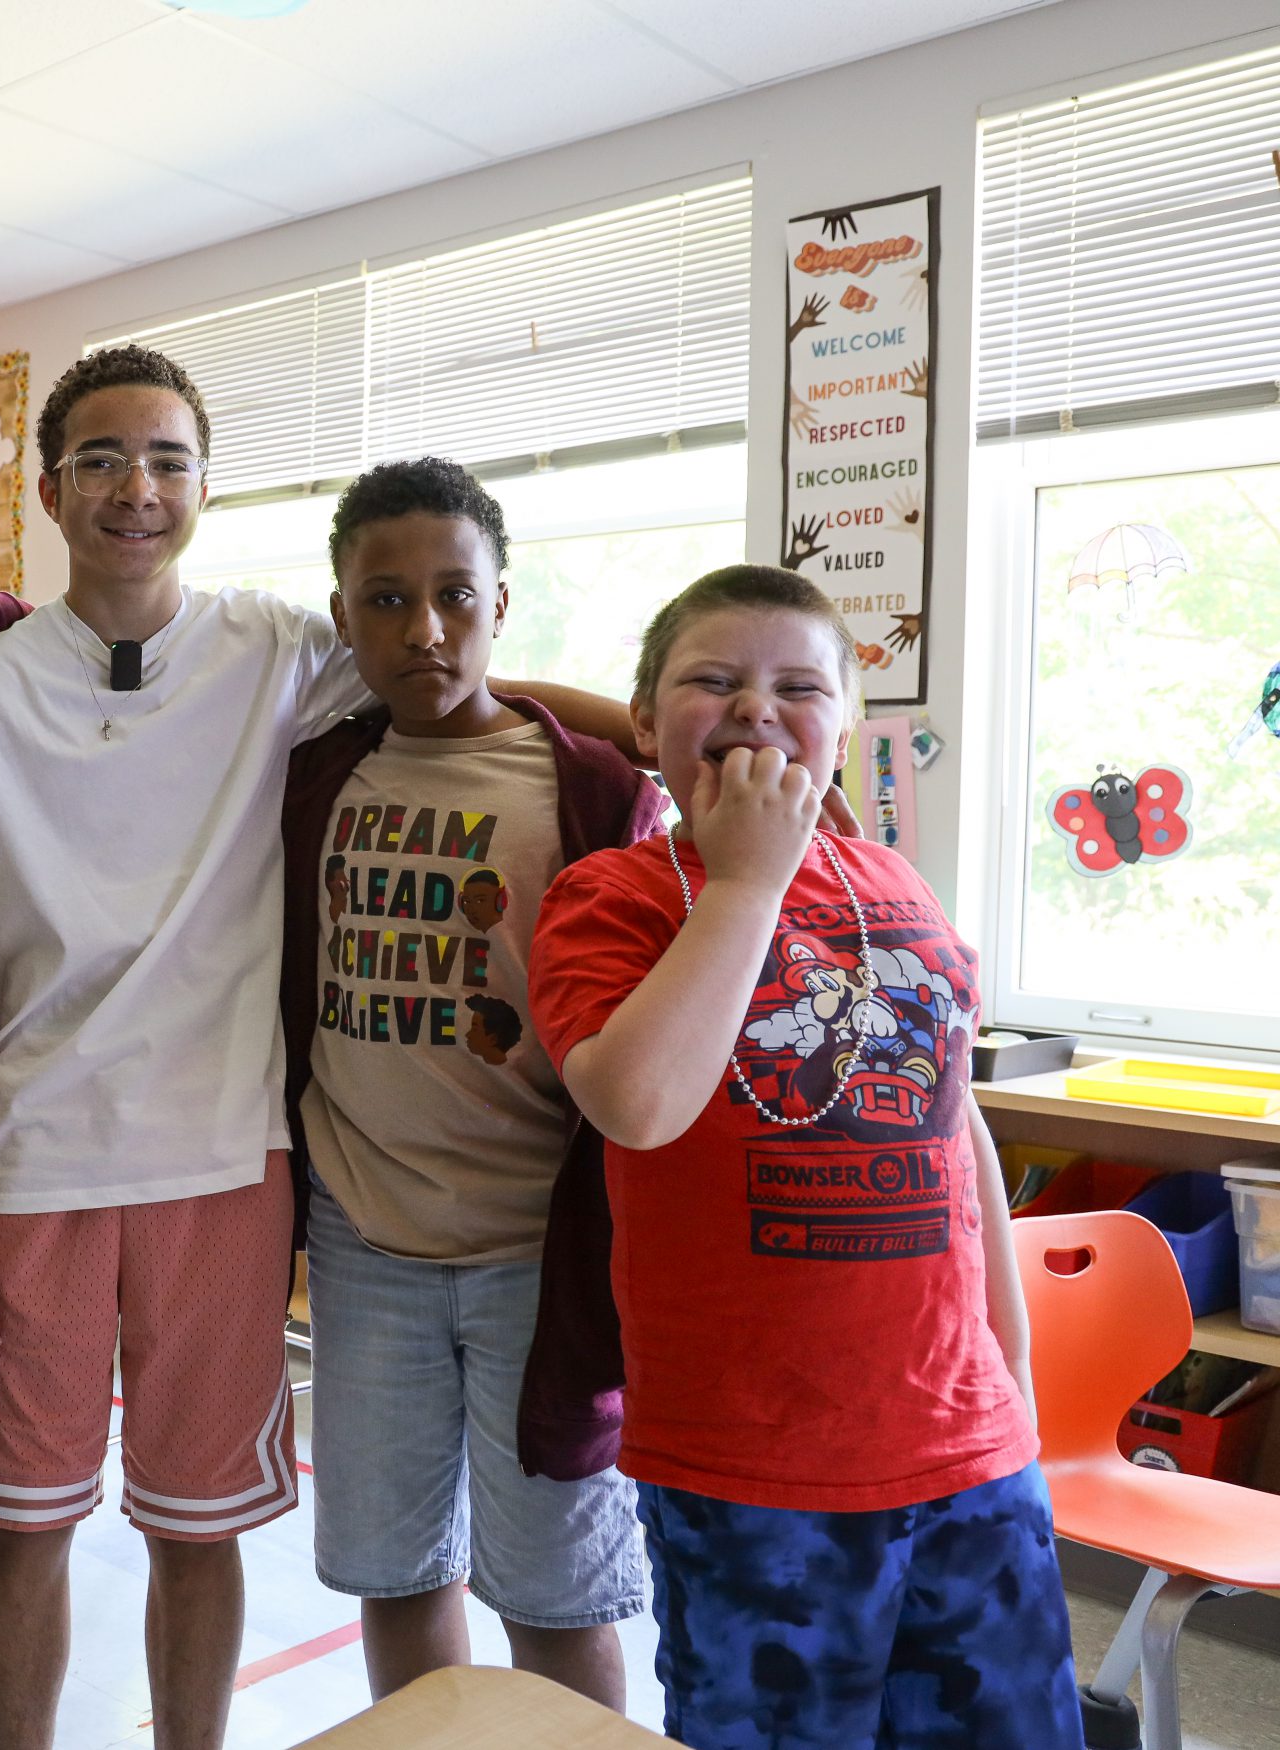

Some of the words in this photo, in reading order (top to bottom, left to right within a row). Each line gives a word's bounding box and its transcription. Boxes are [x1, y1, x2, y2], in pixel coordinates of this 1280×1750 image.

[794, 235, 920, 276] Everyone
[811, 326, 906, 358] WELCOME
[808, 370, 908, 402] IMPORTANT
[809, 415, 906, 445] RESPECTED
[796, 458, 918, 489] ENCOURAGED
[826, 506, 884, 529] LOVED
[824, 551, 885, 572] VALUED
[834, 593, 906, 614] BRATED
[333, 805, 498, 862] DREAM
[350, 866, 455, 922] LEAD
[757, 1164, 870, 1191] BOWSER
[868, 1151, 941, 1194] OIL
[811, 1235, 877, 1253] BULLET
[881, 1234, 917, 1252] BILL
